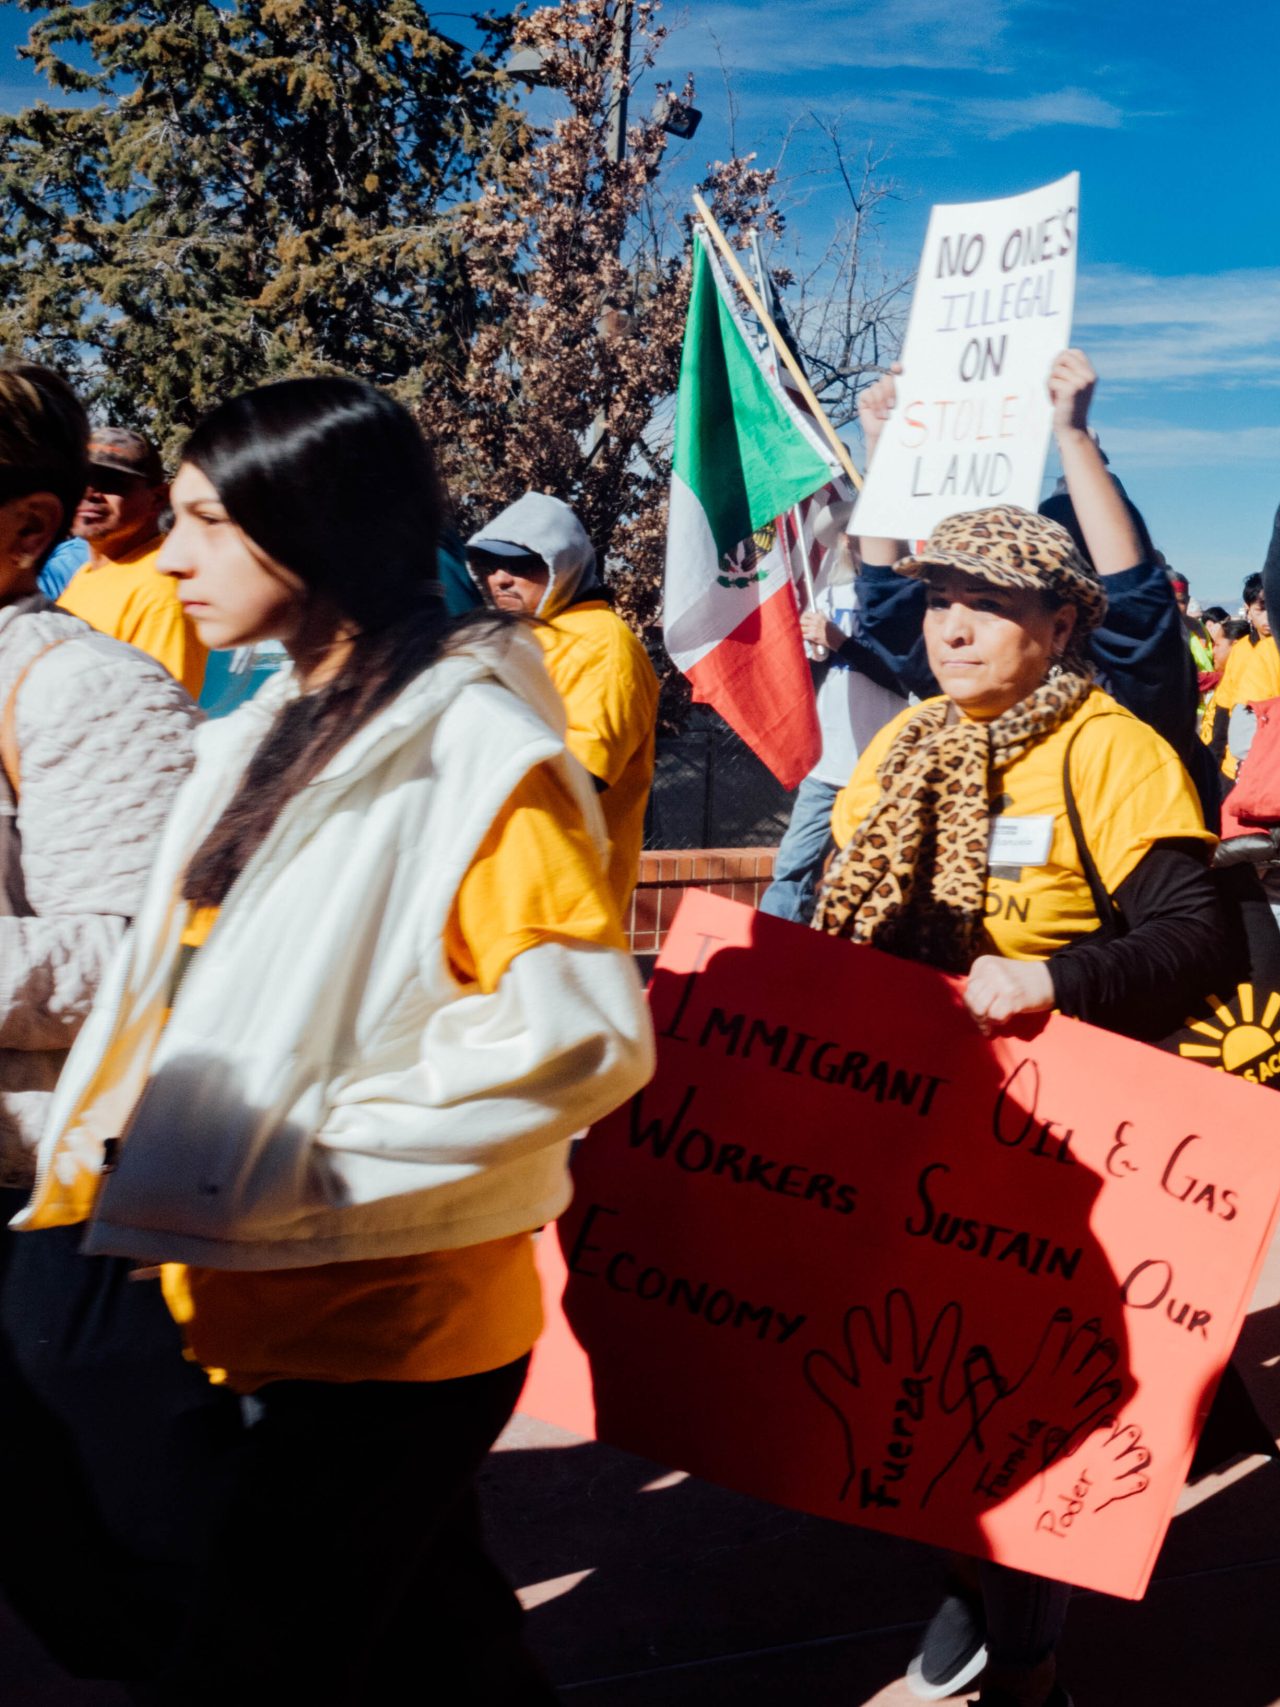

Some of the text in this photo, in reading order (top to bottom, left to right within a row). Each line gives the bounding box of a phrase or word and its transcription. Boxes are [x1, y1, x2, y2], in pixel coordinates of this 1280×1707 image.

[936, 233, 985, 279] NO
[936, 269, 1060, 332] ILLEGAL
[959, 334, 1008, 382] ON
[899, 394, 1038, 449] STOLE
[910, 453, 1013, 497] LAND
[657, 932, 1239, 1222] IMMIGRANT OIL & GAS
[627, 1084, 1085, 1281] WORKERS SUSTAIN
[570, 1203, 1216, 1344] ECONOMY OUR
[860, 1373, 933, 1509] Fuerza
[1035, 1465, 1093, 1541] Poder
